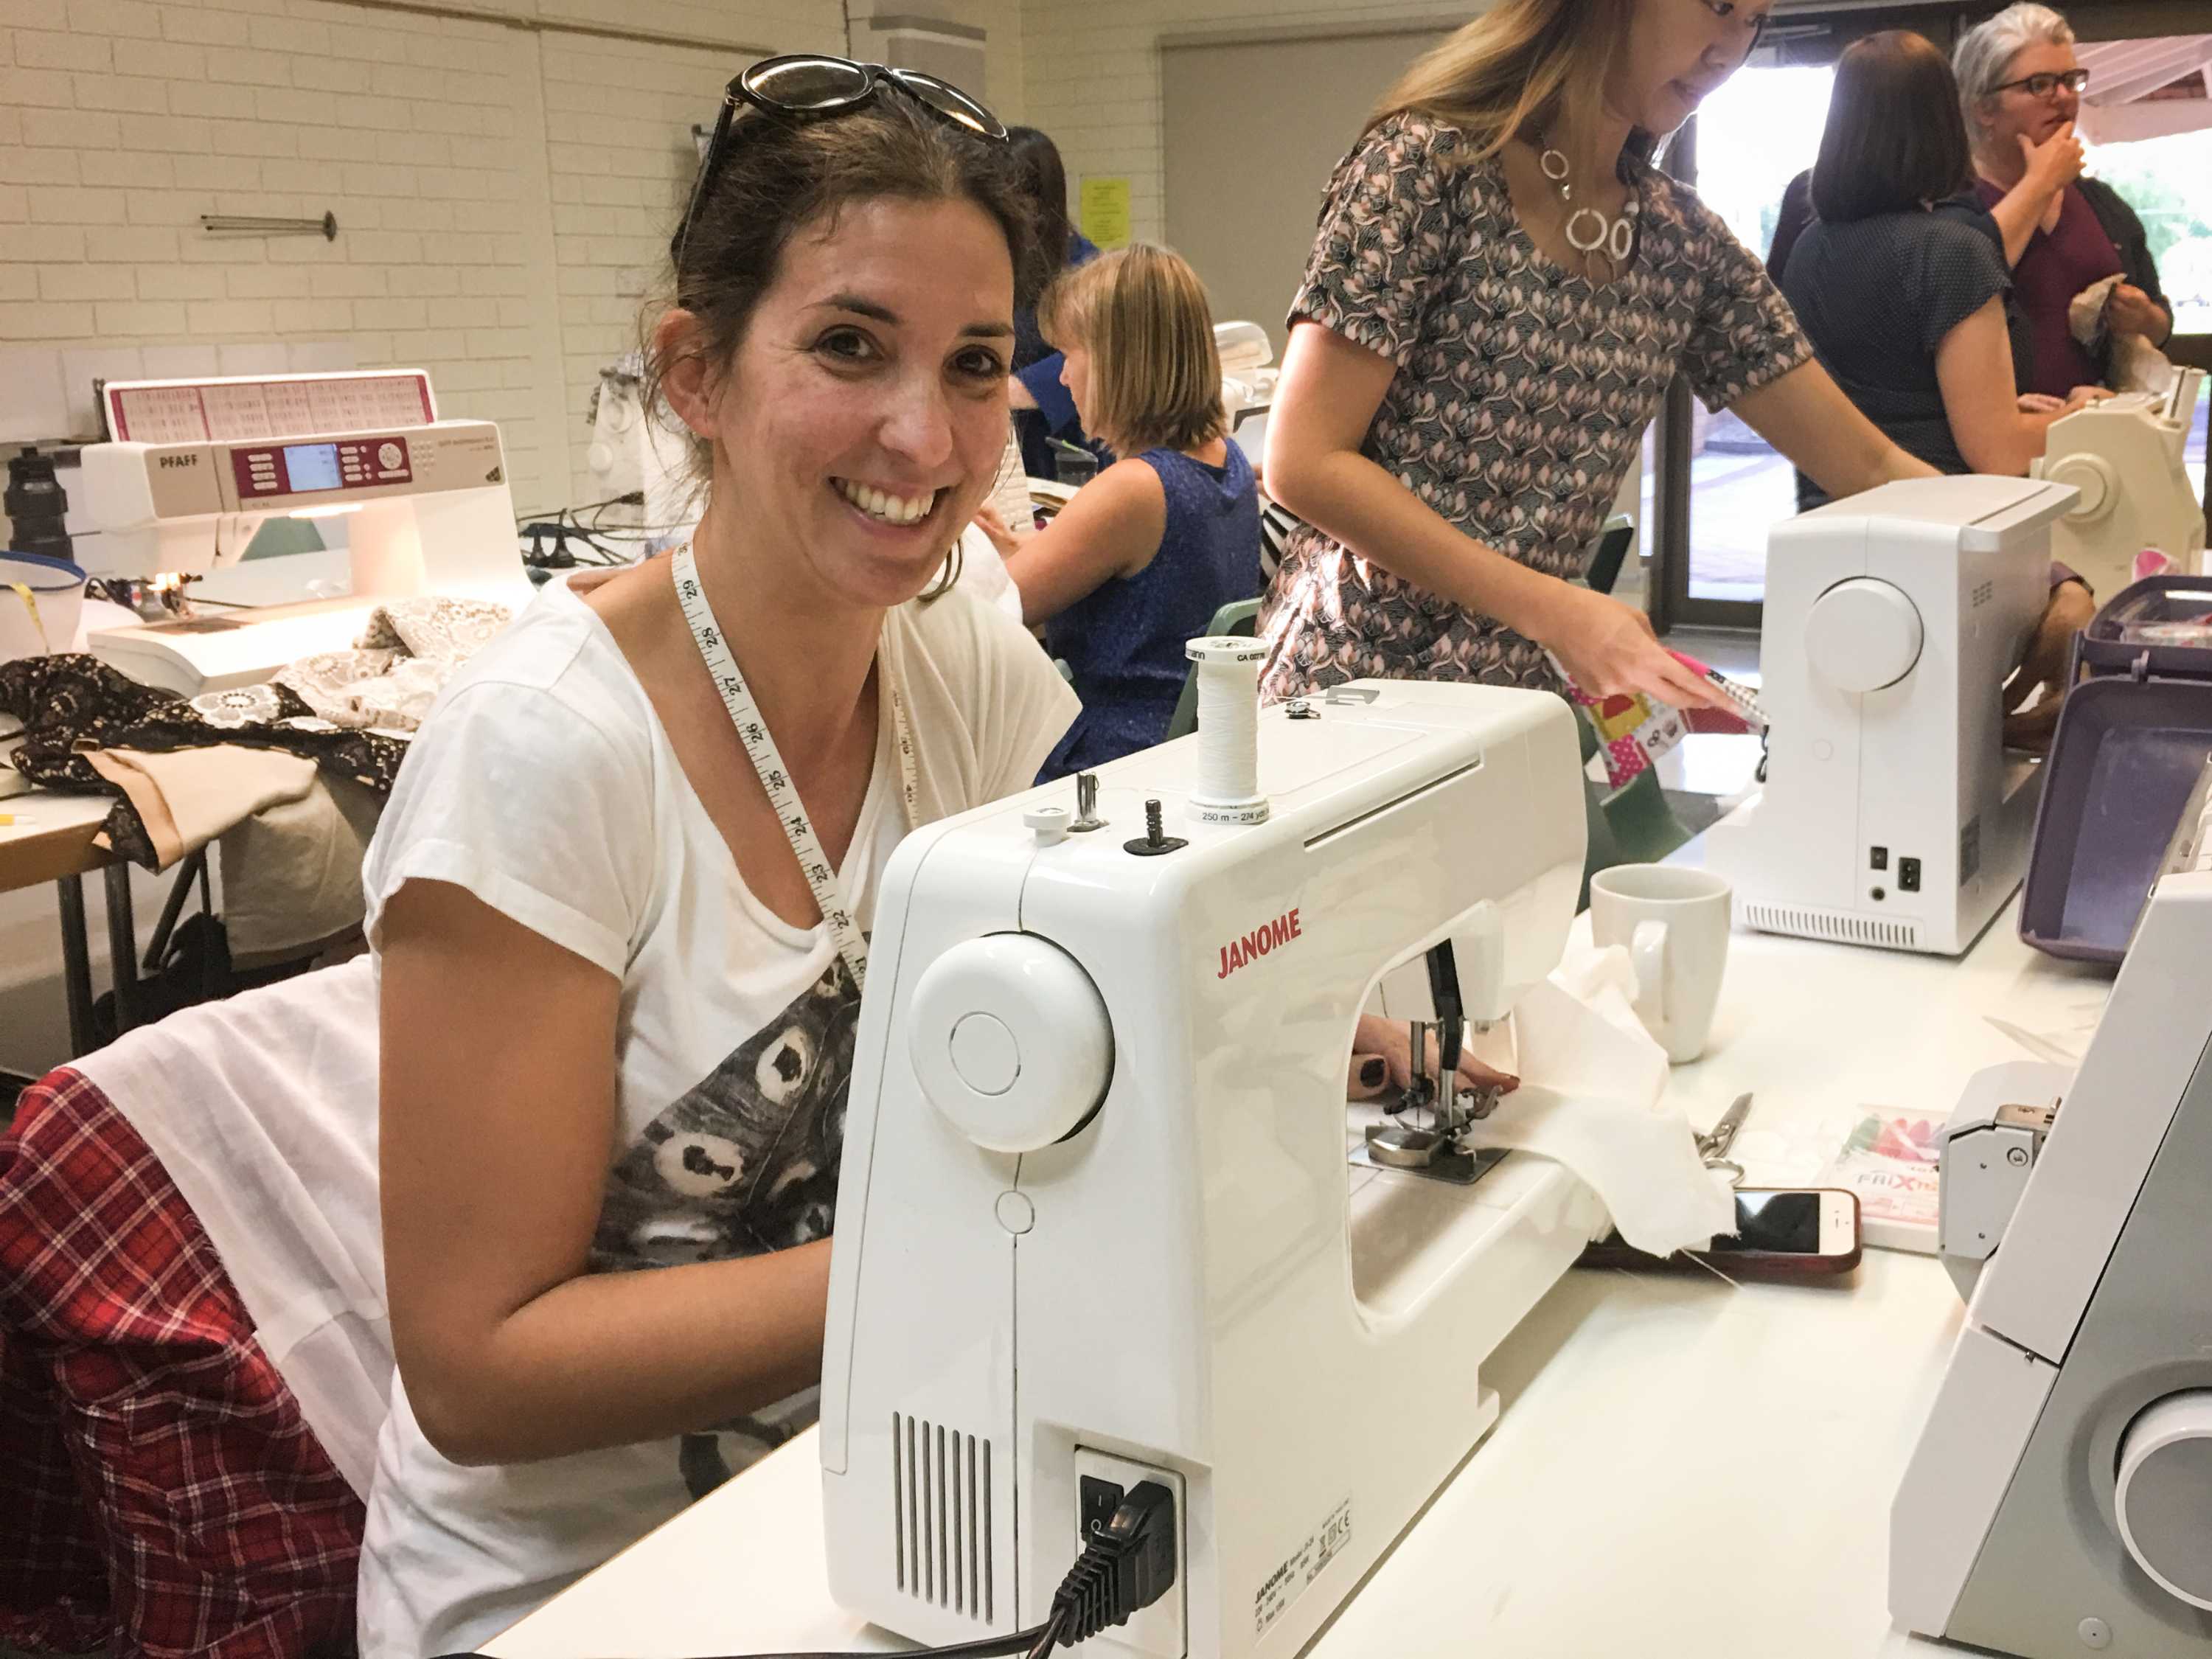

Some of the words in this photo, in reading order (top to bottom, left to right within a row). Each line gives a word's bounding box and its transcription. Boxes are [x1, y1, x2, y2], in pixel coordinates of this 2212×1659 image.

[160, 454, 197, 468] PFAFF
[683, 580, 698, 599] 29
[702, 627, 719, 648] 28
[723, 676, 742, 696] 27
[745, 723, 764, 744] 26
[768, 771, 786, 790] 25
[790, 816, 808, 835] 24
[1203, 812, 1218, 821] 250
[1241, 812, 1254, 821] 274
[812, 863, 829, 883] 23
[832, 910, 849, 930] 22
[1217, 908, 1301, 979] JANOME
[1255, 1560, 1289, 1604] JANOME
